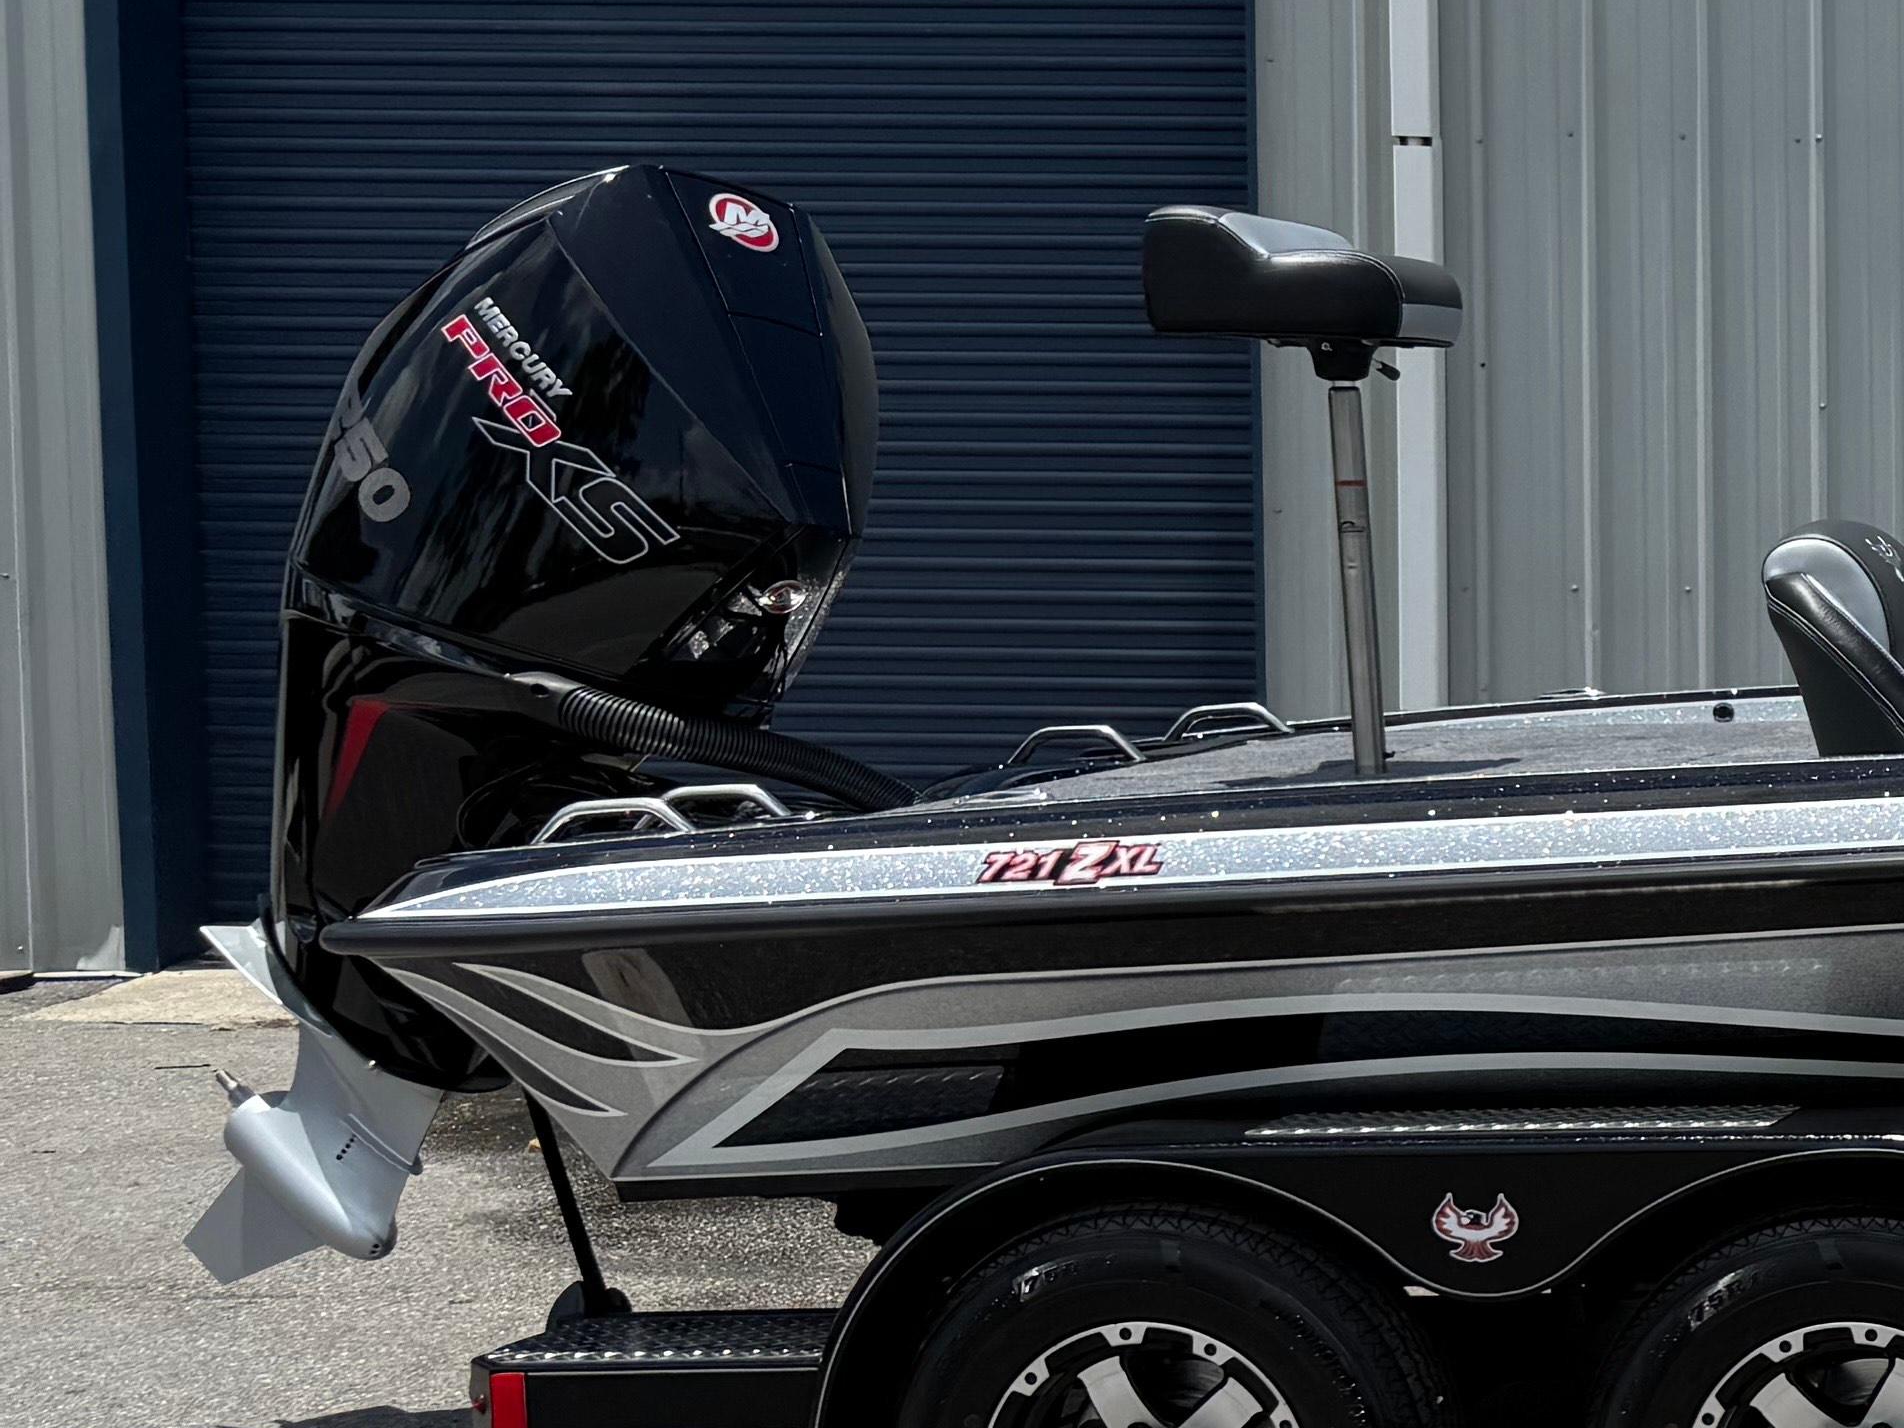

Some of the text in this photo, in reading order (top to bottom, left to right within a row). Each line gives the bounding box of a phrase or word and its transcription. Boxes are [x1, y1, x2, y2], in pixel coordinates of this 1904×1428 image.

[441, 313, 562, 448] PRO
[473, 296, 574, 398] MERCURY
[471, 387, 681, 565] XS
